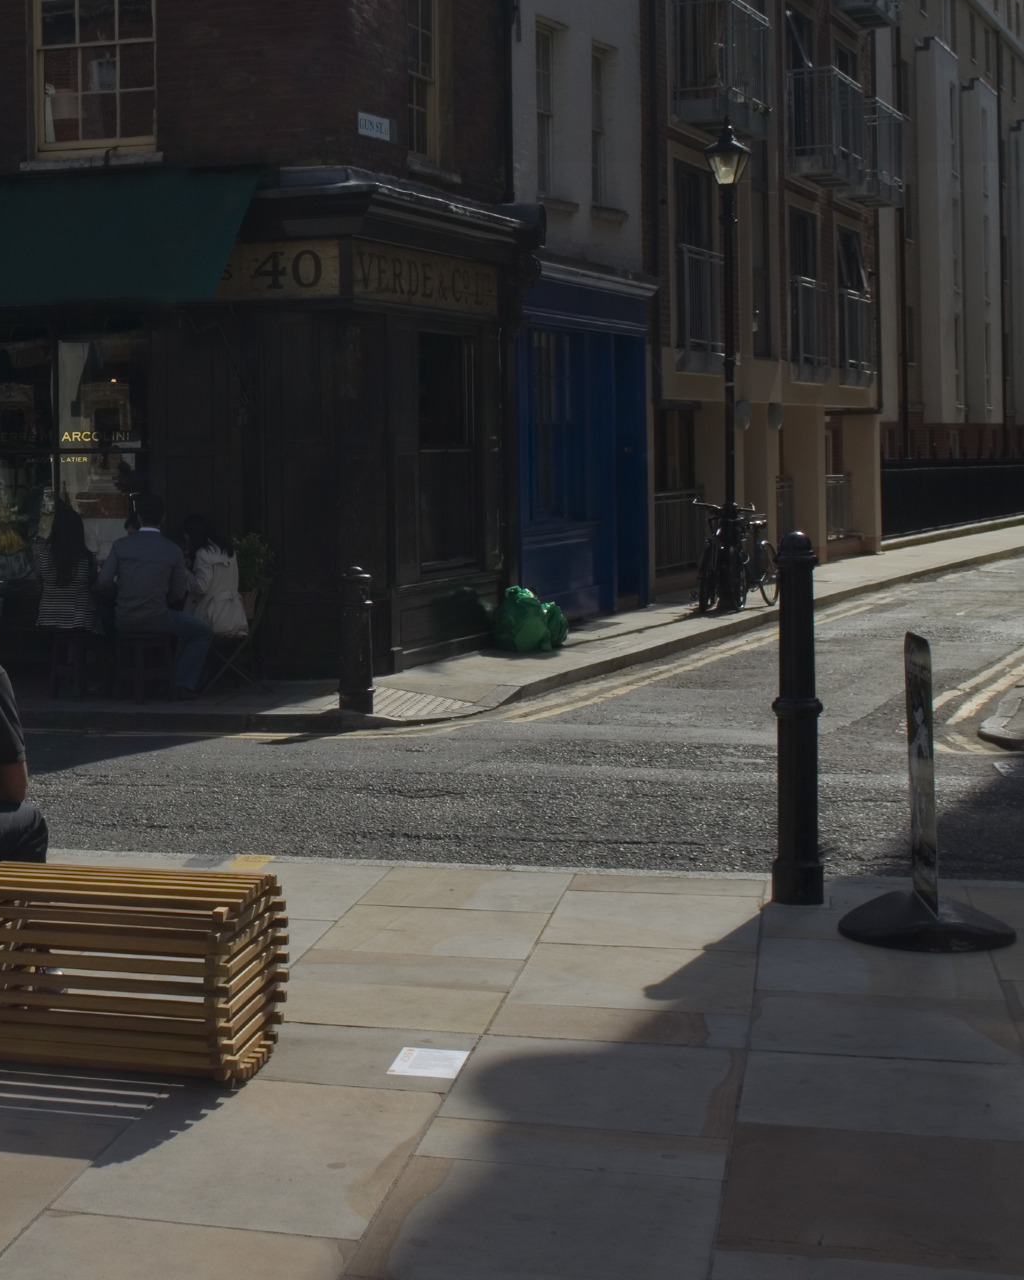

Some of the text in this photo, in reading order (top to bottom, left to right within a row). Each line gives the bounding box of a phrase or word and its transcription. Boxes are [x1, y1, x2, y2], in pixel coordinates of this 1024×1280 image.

[359, 117, 374, 131] GUN
[251, 249, 322, 290] 40
[356, 248, 434, 298] VERDE
[438, 272, 448, 301] &
